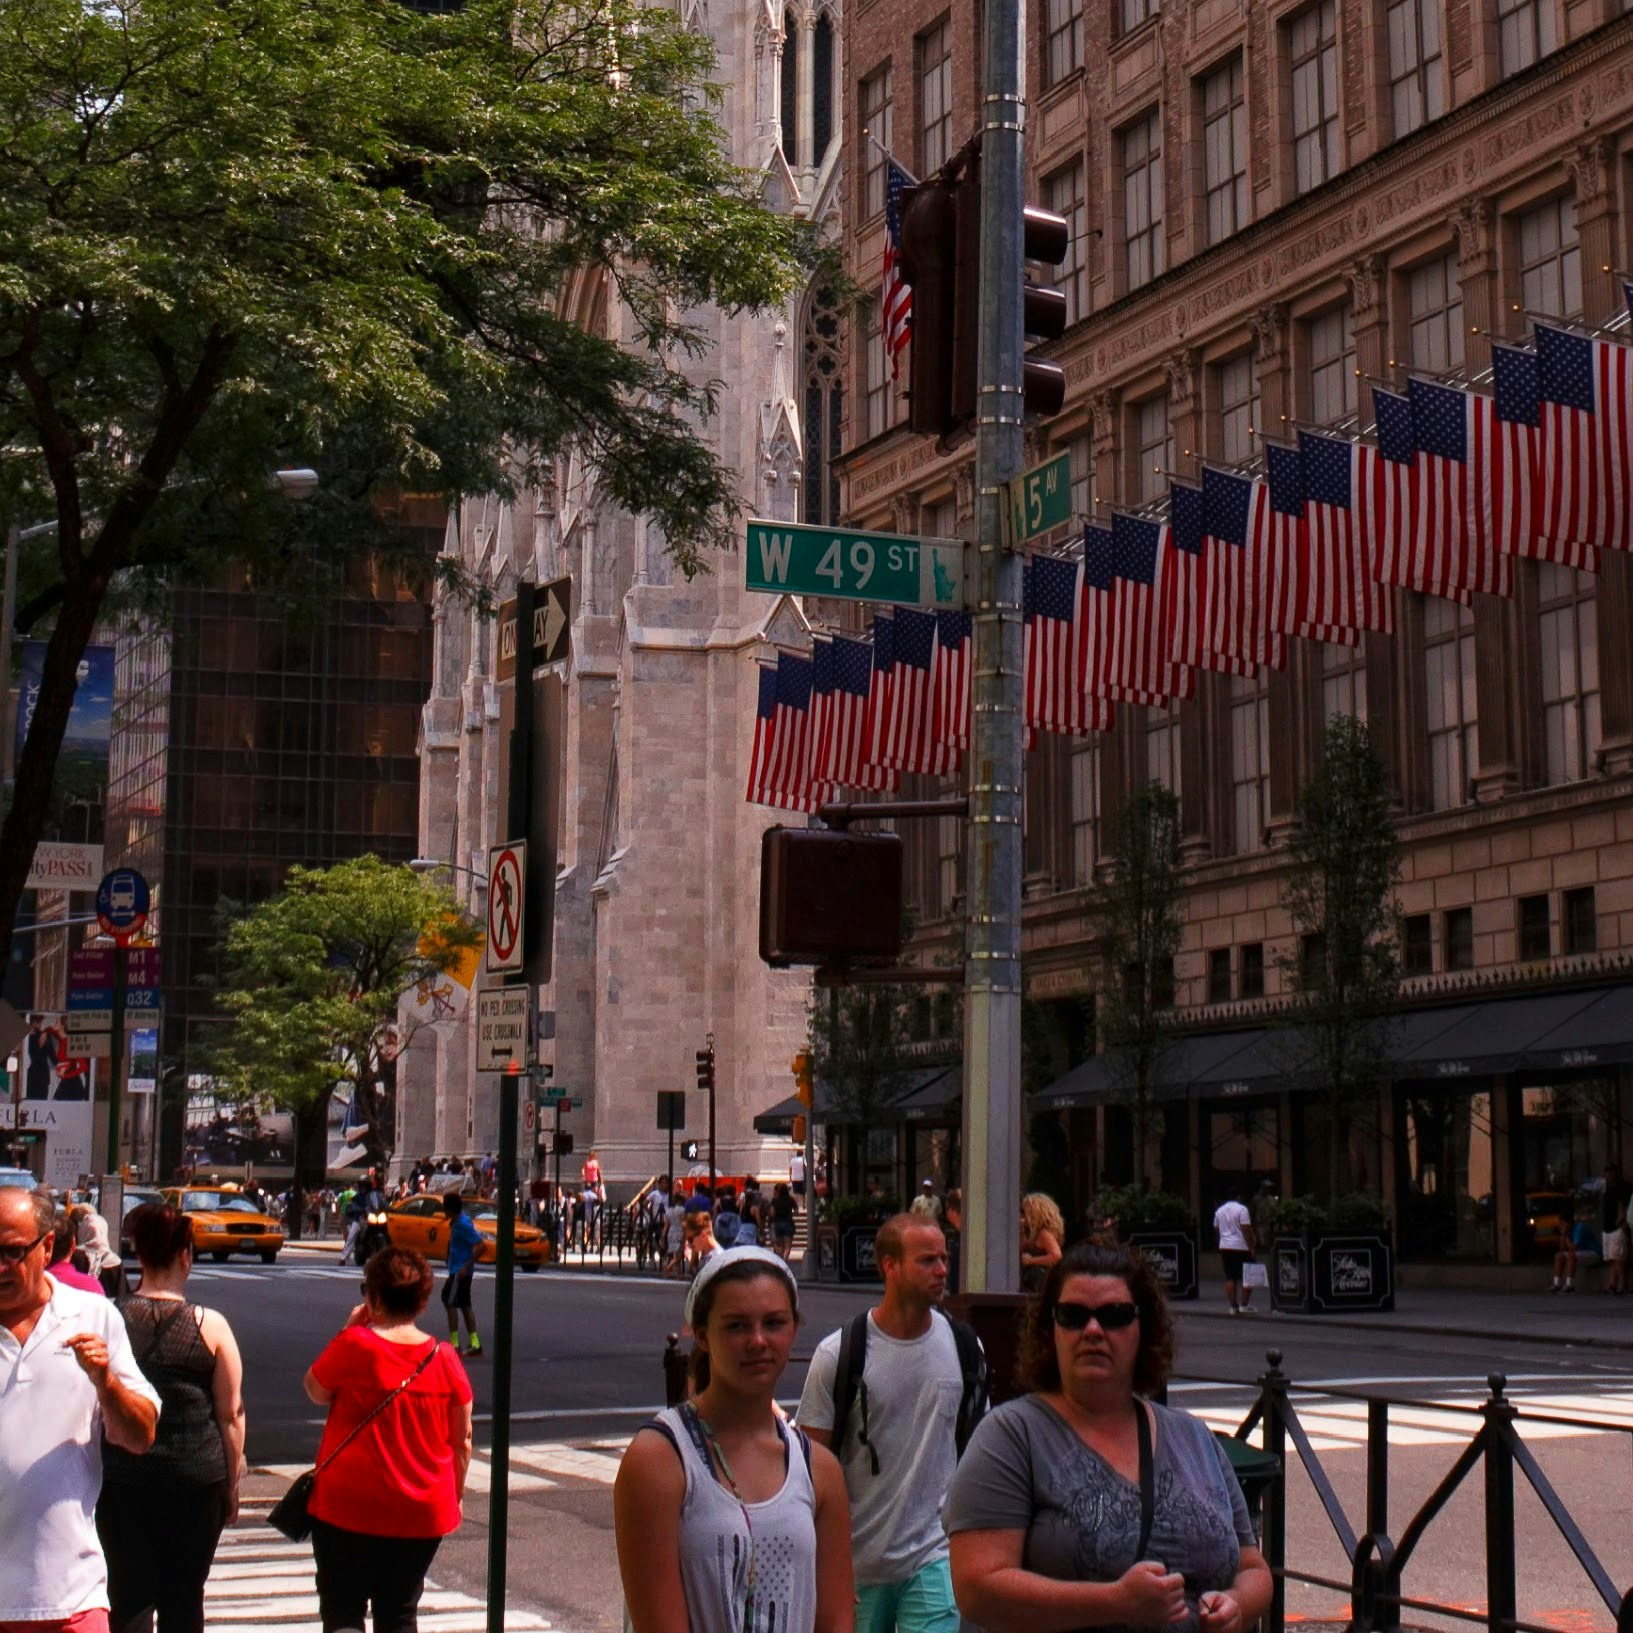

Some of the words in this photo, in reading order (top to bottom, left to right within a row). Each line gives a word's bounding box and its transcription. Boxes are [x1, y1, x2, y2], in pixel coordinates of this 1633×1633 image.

[1029, 475, 1043, 529] 5
[1045, 465, 1058, 497] AV
[758, 531, 794, 585] W
[814, 539, 876, 590] 49
[887, 545, 920, 573] ST
[128, 950, 146, 965] M1
[128, 970, 146, 985] M4
[127, 990, 153, 1007] Q32
